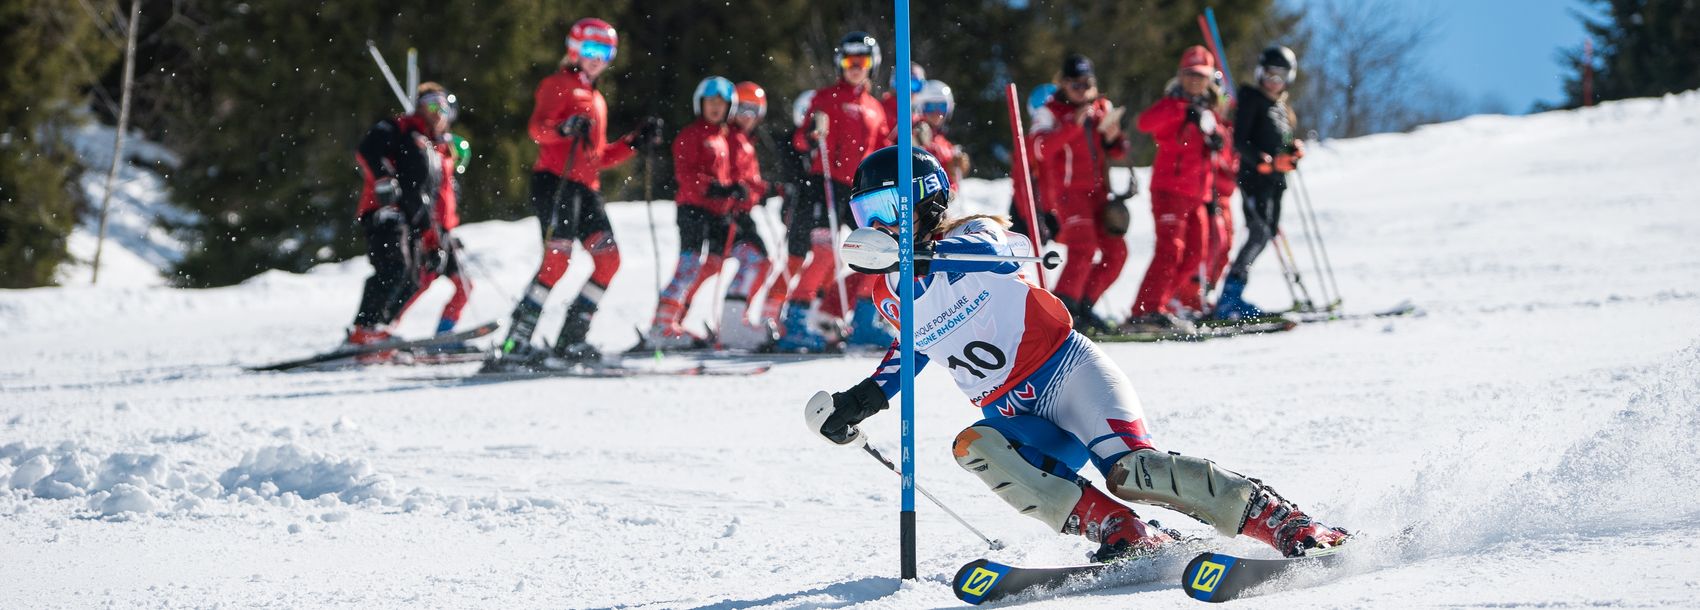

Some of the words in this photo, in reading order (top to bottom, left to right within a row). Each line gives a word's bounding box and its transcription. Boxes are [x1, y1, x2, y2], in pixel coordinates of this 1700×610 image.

[932, 295, 970, 327] POPULAIRE
[936, 312, 966, 337] RHÔNE
[965, 290, 990, 315] ALPES
[947, 341, 1006, 379] 10
